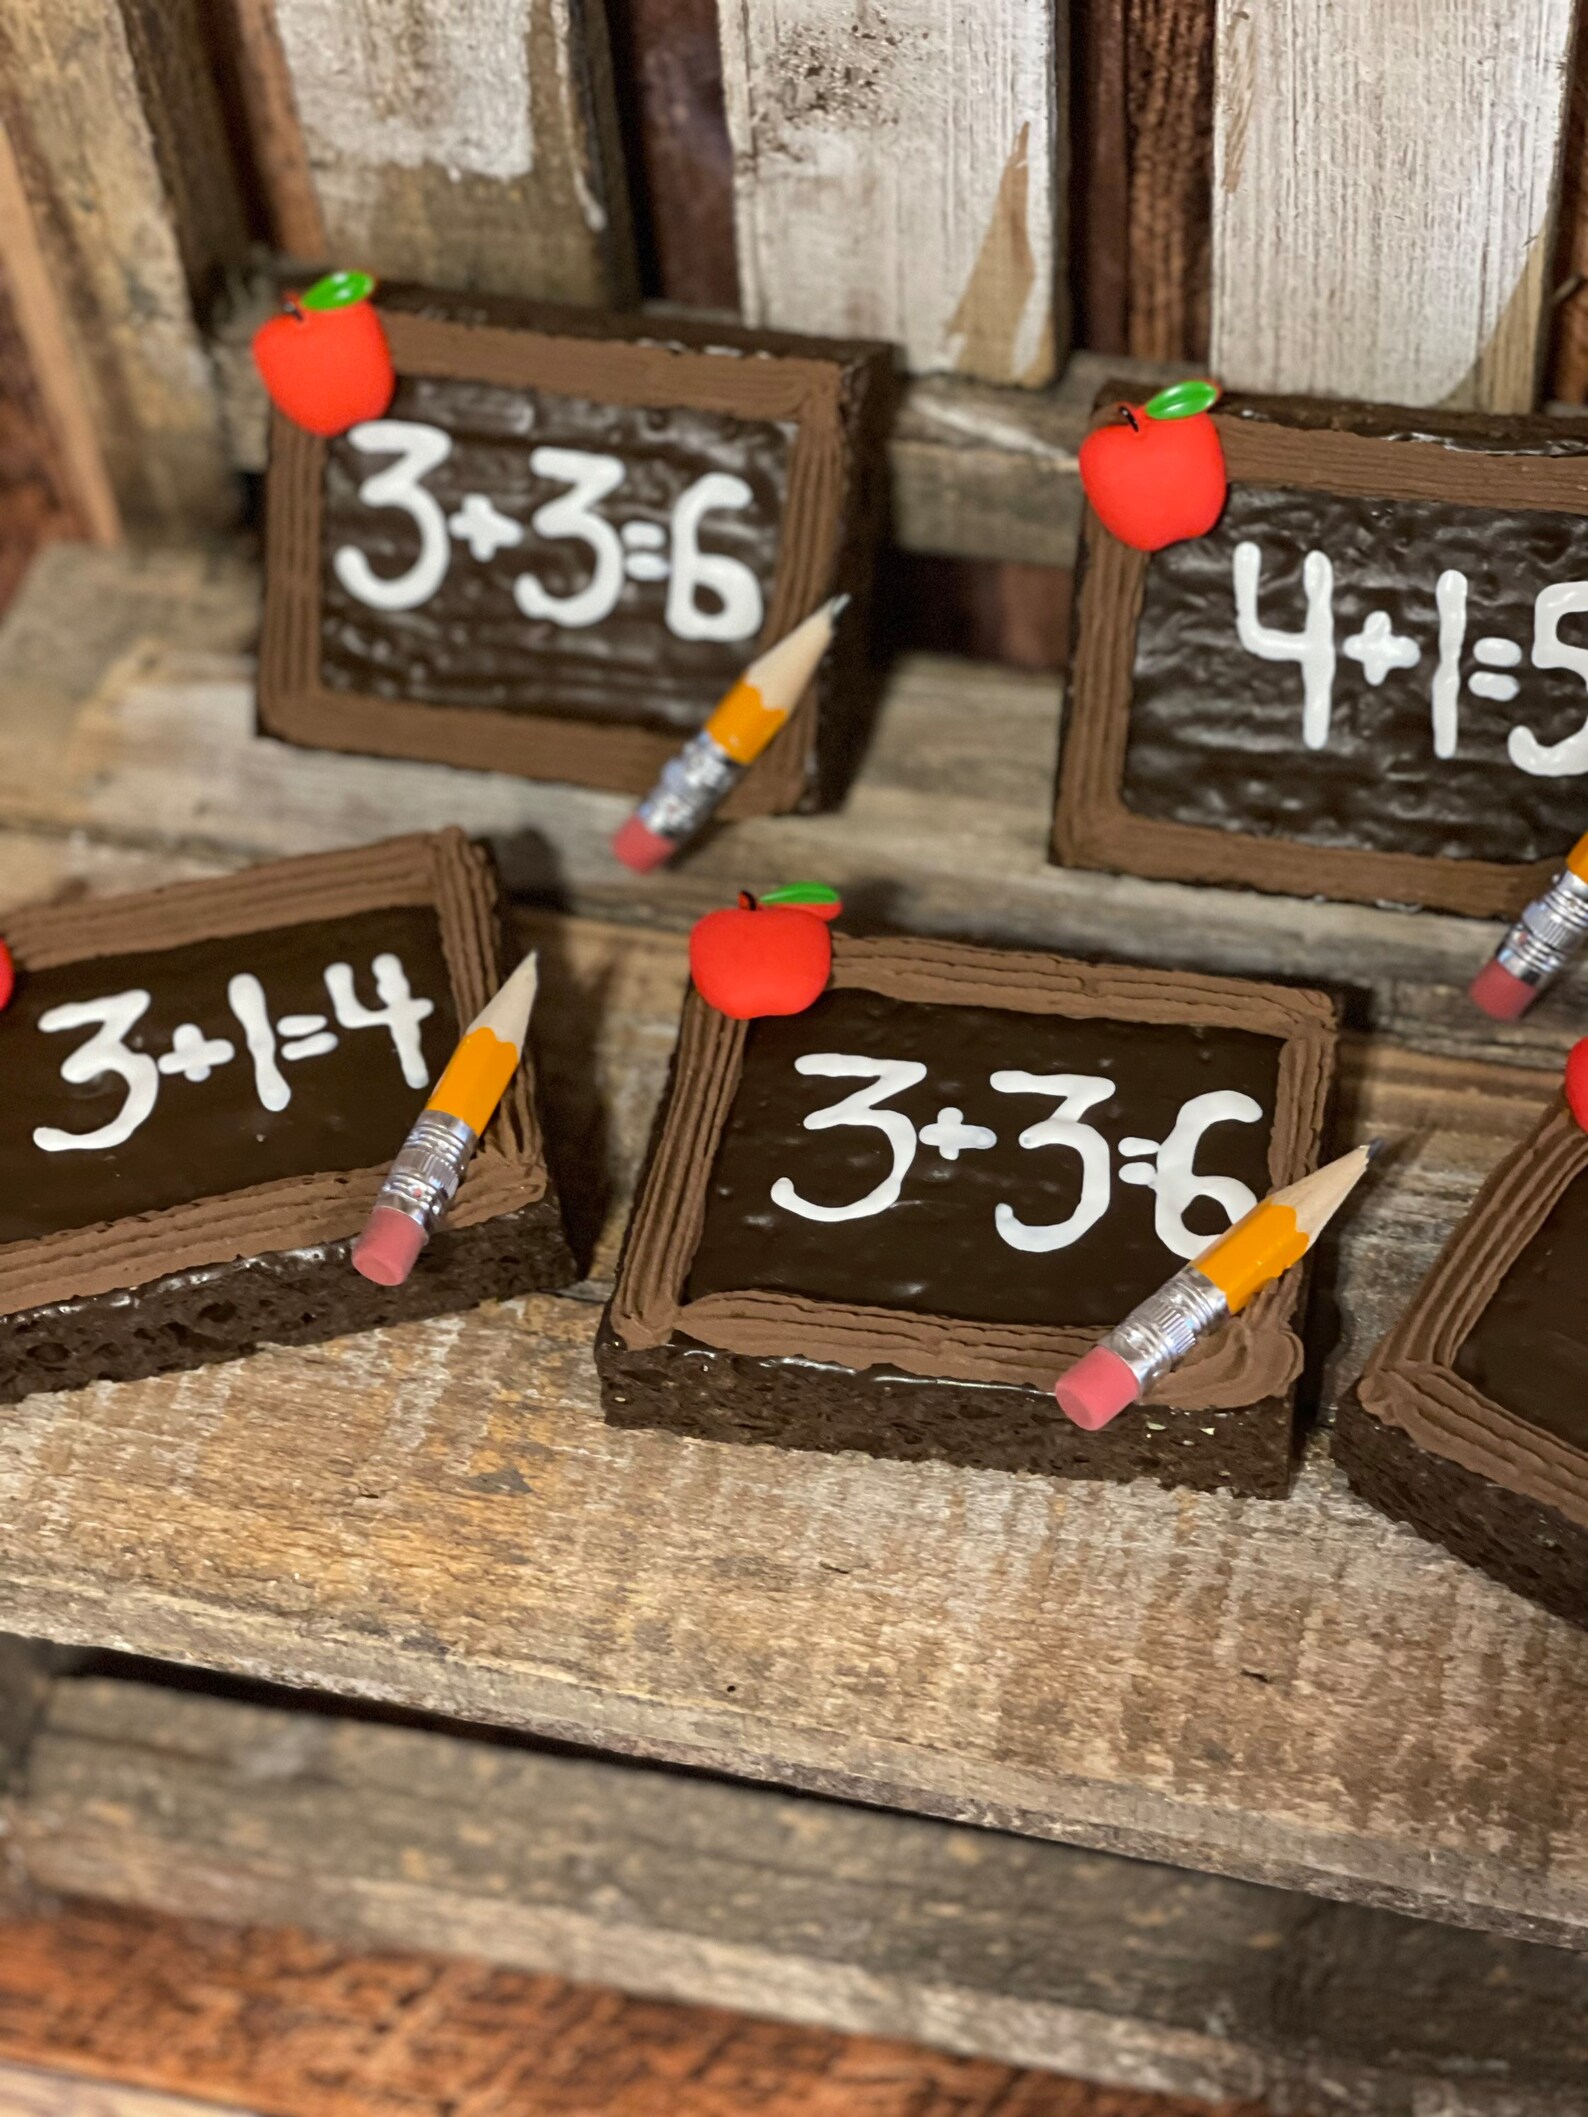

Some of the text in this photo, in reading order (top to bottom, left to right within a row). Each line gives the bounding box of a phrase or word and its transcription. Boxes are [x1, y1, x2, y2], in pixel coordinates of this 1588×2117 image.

[334, 420, 763, 641] 3+3=6
[1232, 541, 1588, 777] 4+1=5
[33, 954, 433, 1152] 3+1=4
[770, 1053, 1264, 1261] 3+3=6
